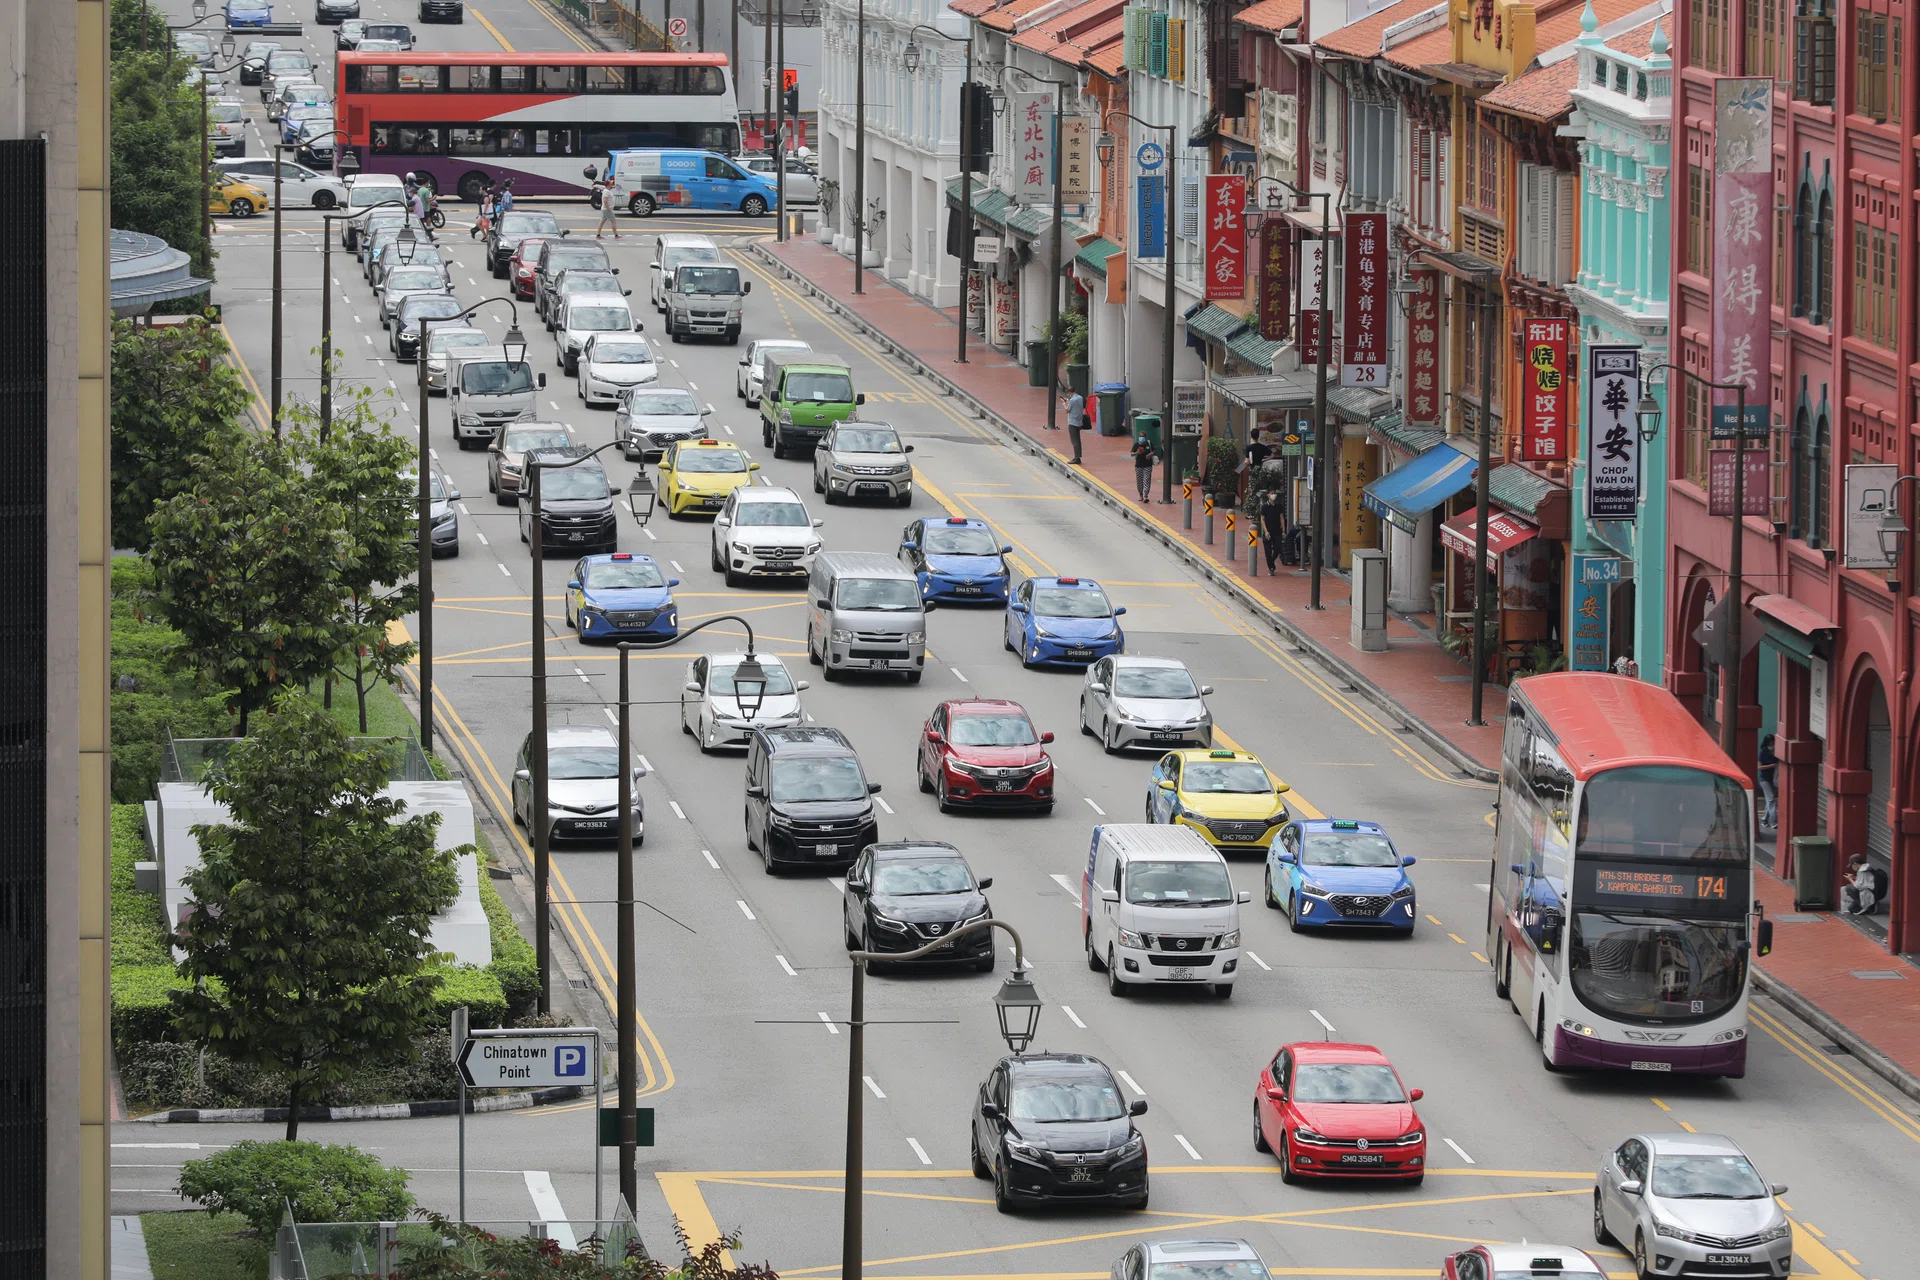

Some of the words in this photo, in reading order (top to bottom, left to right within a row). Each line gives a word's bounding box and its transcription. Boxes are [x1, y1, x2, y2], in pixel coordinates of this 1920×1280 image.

[1024, 101, 1044, 186] 东北小厨
[1211, 182, 1240, 282] 东北人家
[1722, 187, 1762, 390] 康得美
[1530, 324, 1563, 341] 东北
[1354, 352, 1376, 362] 甜品
[1355, 367, 1375, 382] 28
[1535, 394, 1556, 456] 饺子馆
[1596, 378, 1633, 462] 華安
[1750, 414, 1756, 422] &
[1617, 872, 1632, 881] STH
[1634, 873, 1660, 882] BRIDGE
[1663, 875, 1673, 883] RD
[1698, 876, 1725, 898] 174
[1608, 882, 1641, 892] KAMPONG
[1669, 885, 1683, 895] TER
[484, 1046, 546, 1058] Chinatown
[560, 1049, 580, 1074] P
[500, 1066, 530, 1078] Point
